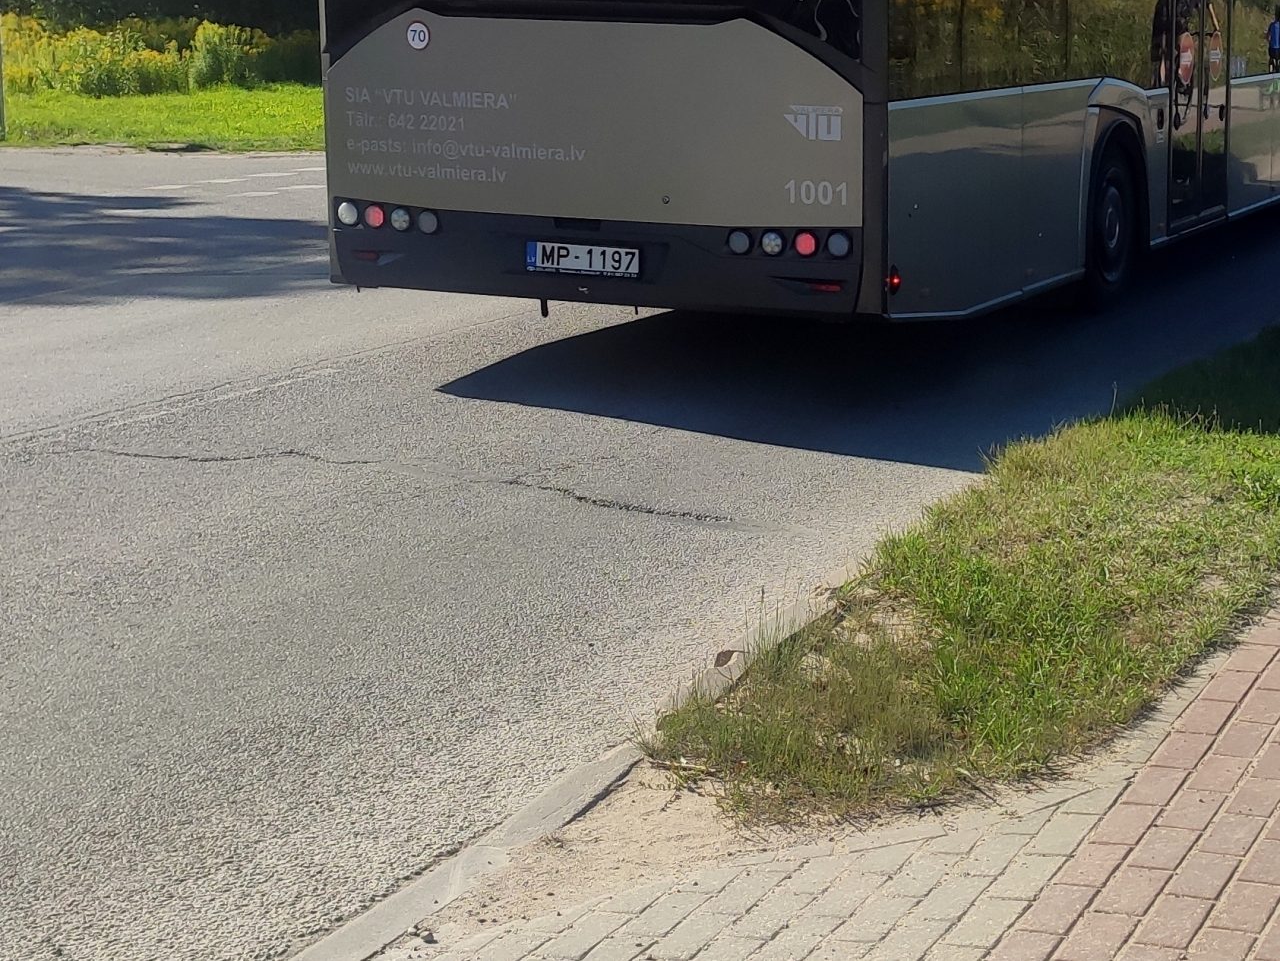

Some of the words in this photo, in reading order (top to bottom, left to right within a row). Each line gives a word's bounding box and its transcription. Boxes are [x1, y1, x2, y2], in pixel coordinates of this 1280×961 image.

[410, 29, 427, 43] 70
[345, 87, 371, 103] SIA
[388, 113, 416, 129] 642
[419, 114, 465, 132] 22021
[412, 139, 586, 162] info@vtu-valmiera.lv
[347, 160, 508, 183] www.vtu-valmiera.lv
[784, 179, 848, 206] 1001
